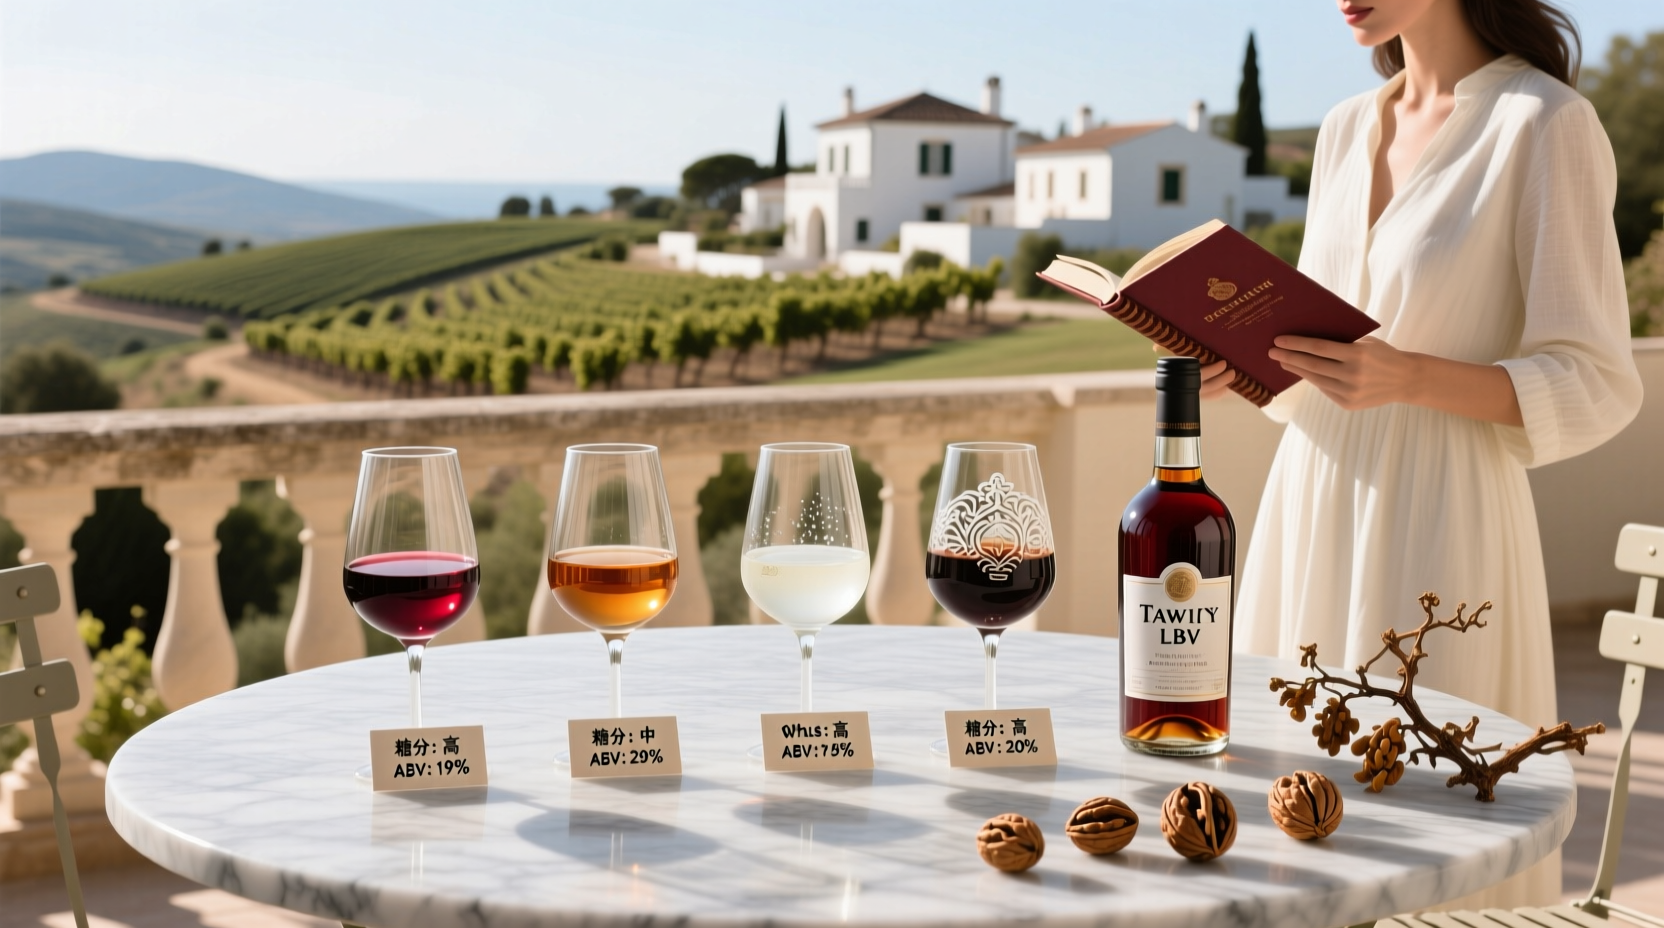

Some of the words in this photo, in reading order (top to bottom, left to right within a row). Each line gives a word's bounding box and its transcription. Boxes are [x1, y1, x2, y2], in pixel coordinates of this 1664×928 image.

[1160, 628, 1201, 645] LBV
[781, 744, 819, 760] ABV:
[964, 741, 1002, 756] ABV:
[1005, 738, 1039, 754] 20%
[393, 762, 432, 779] ABV:
[436, 758, 470, 776] 19%
